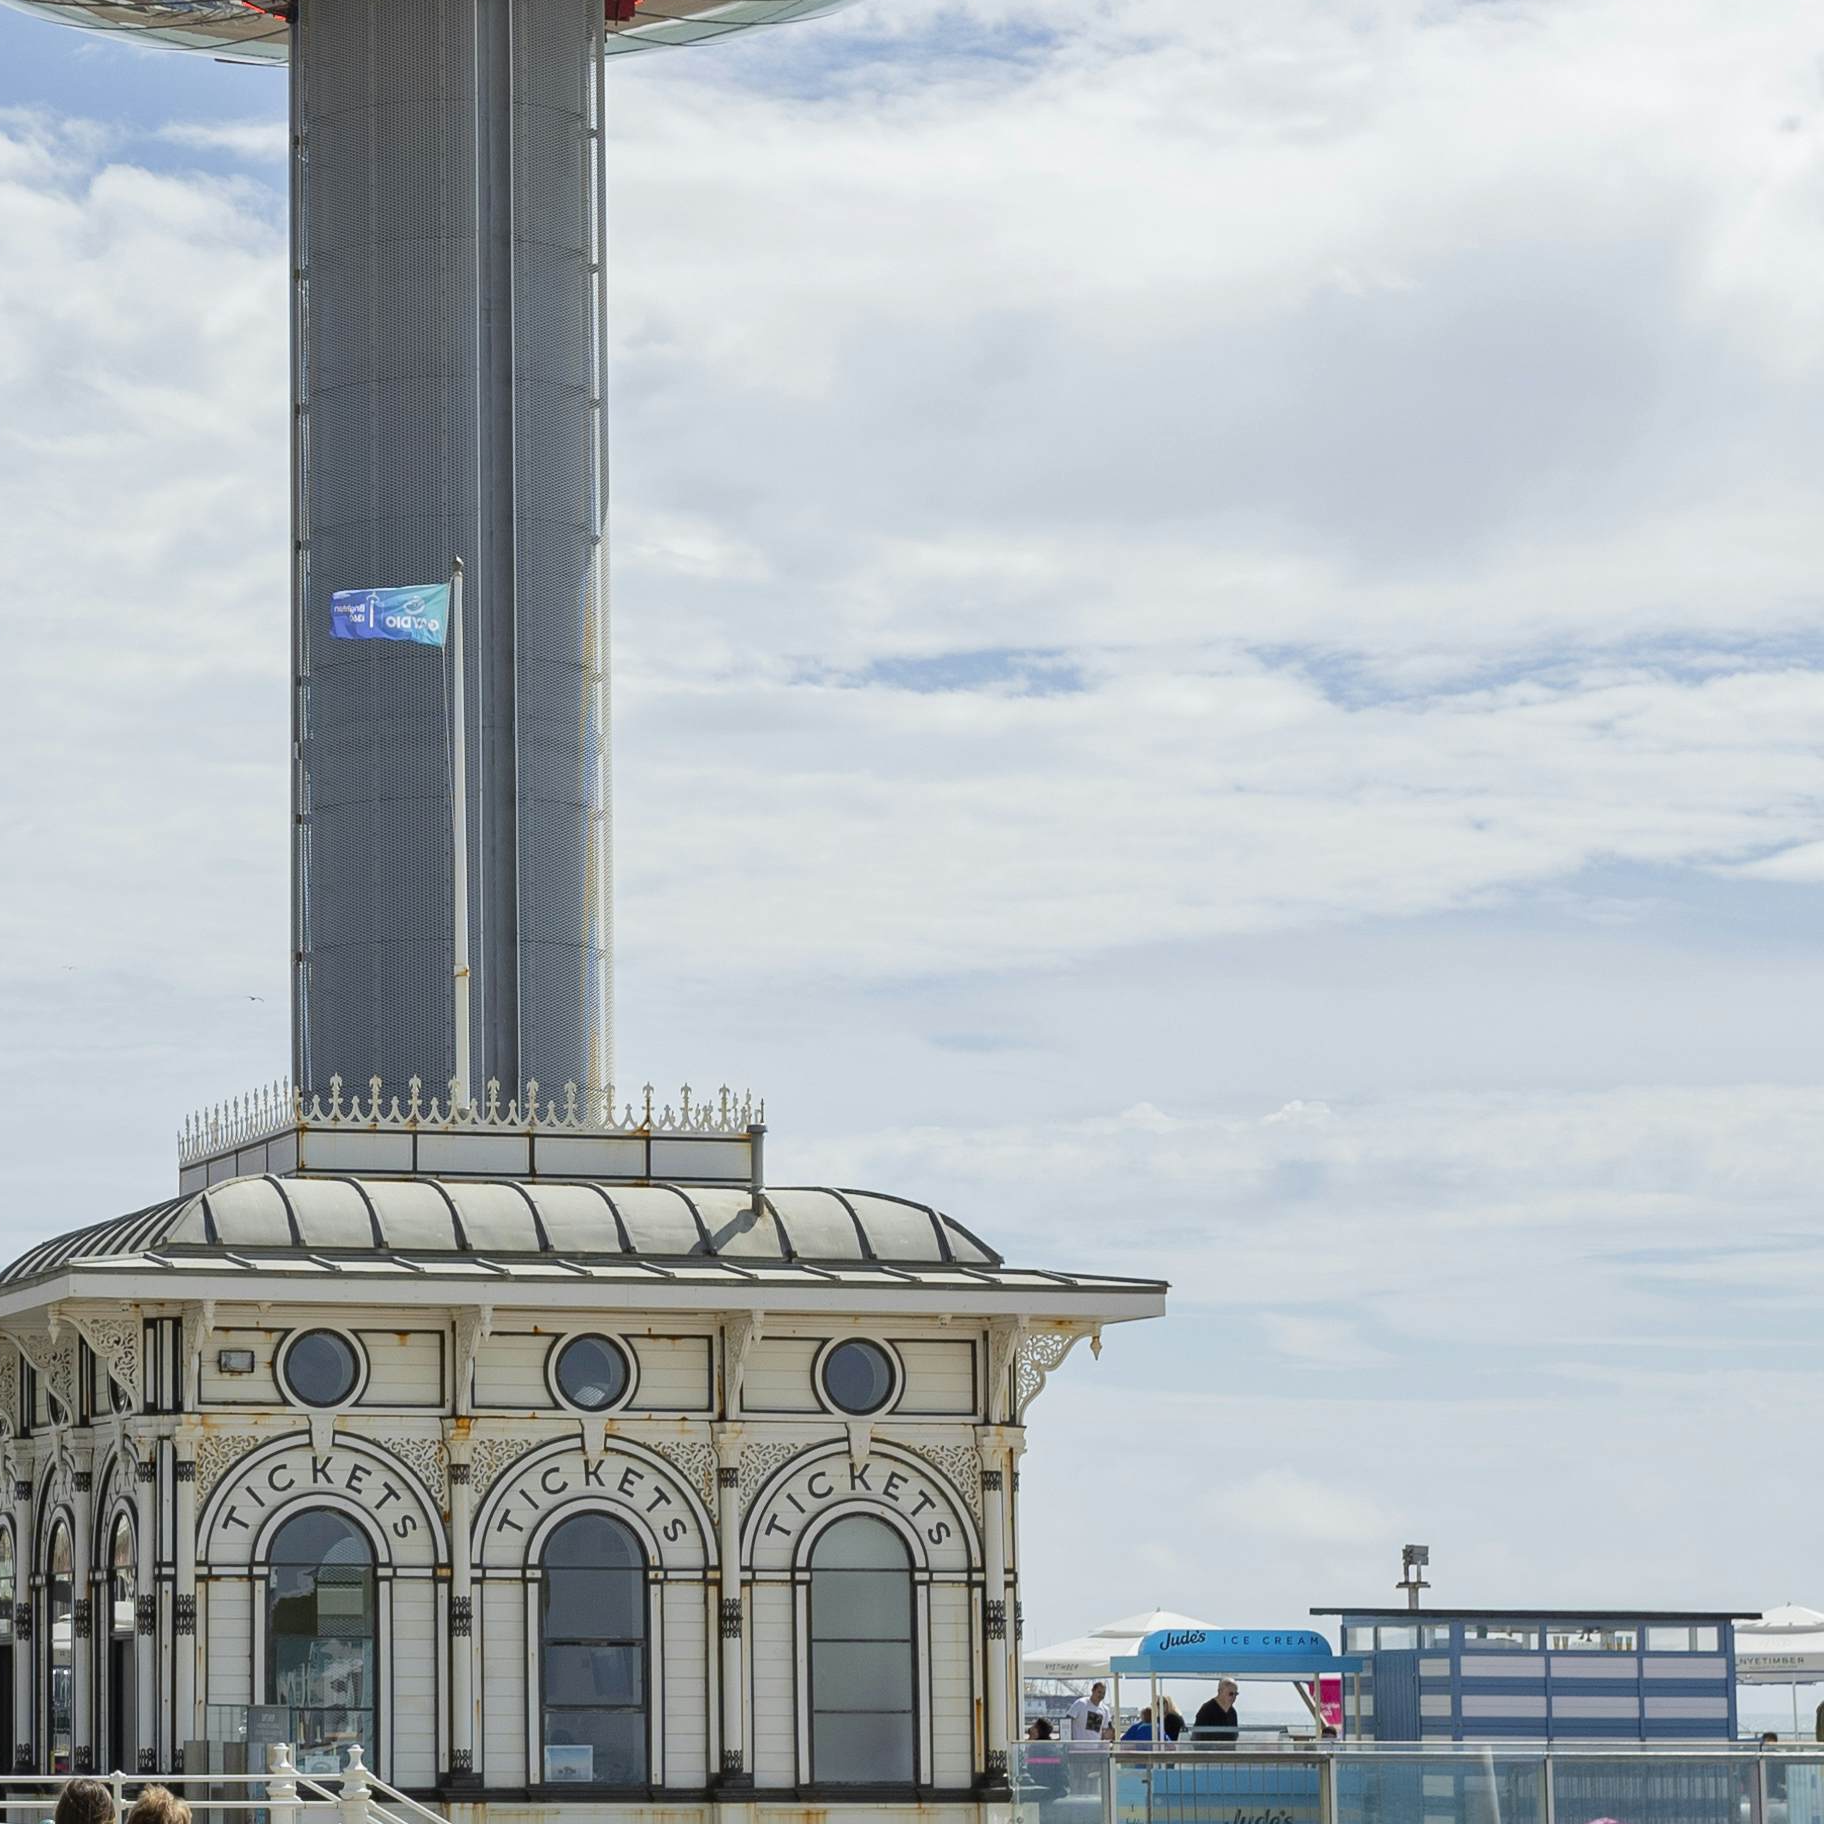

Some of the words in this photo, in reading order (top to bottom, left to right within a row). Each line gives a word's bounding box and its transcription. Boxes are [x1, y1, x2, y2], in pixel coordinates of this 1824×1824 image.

[221, 1455, 417, 1539] TICKETS
[496, 1459, 688, 1542] TICKETS
[765, 1462, 951, 1545] TICKETS
[1160, 1629, 1206, 1651] Jude's
[1223, 1635, 1250, 1645] ICE
[1263, 1635, 1319, 1646] CREAM
[1739, 1656, 1804, 1665] NYETIMBER
